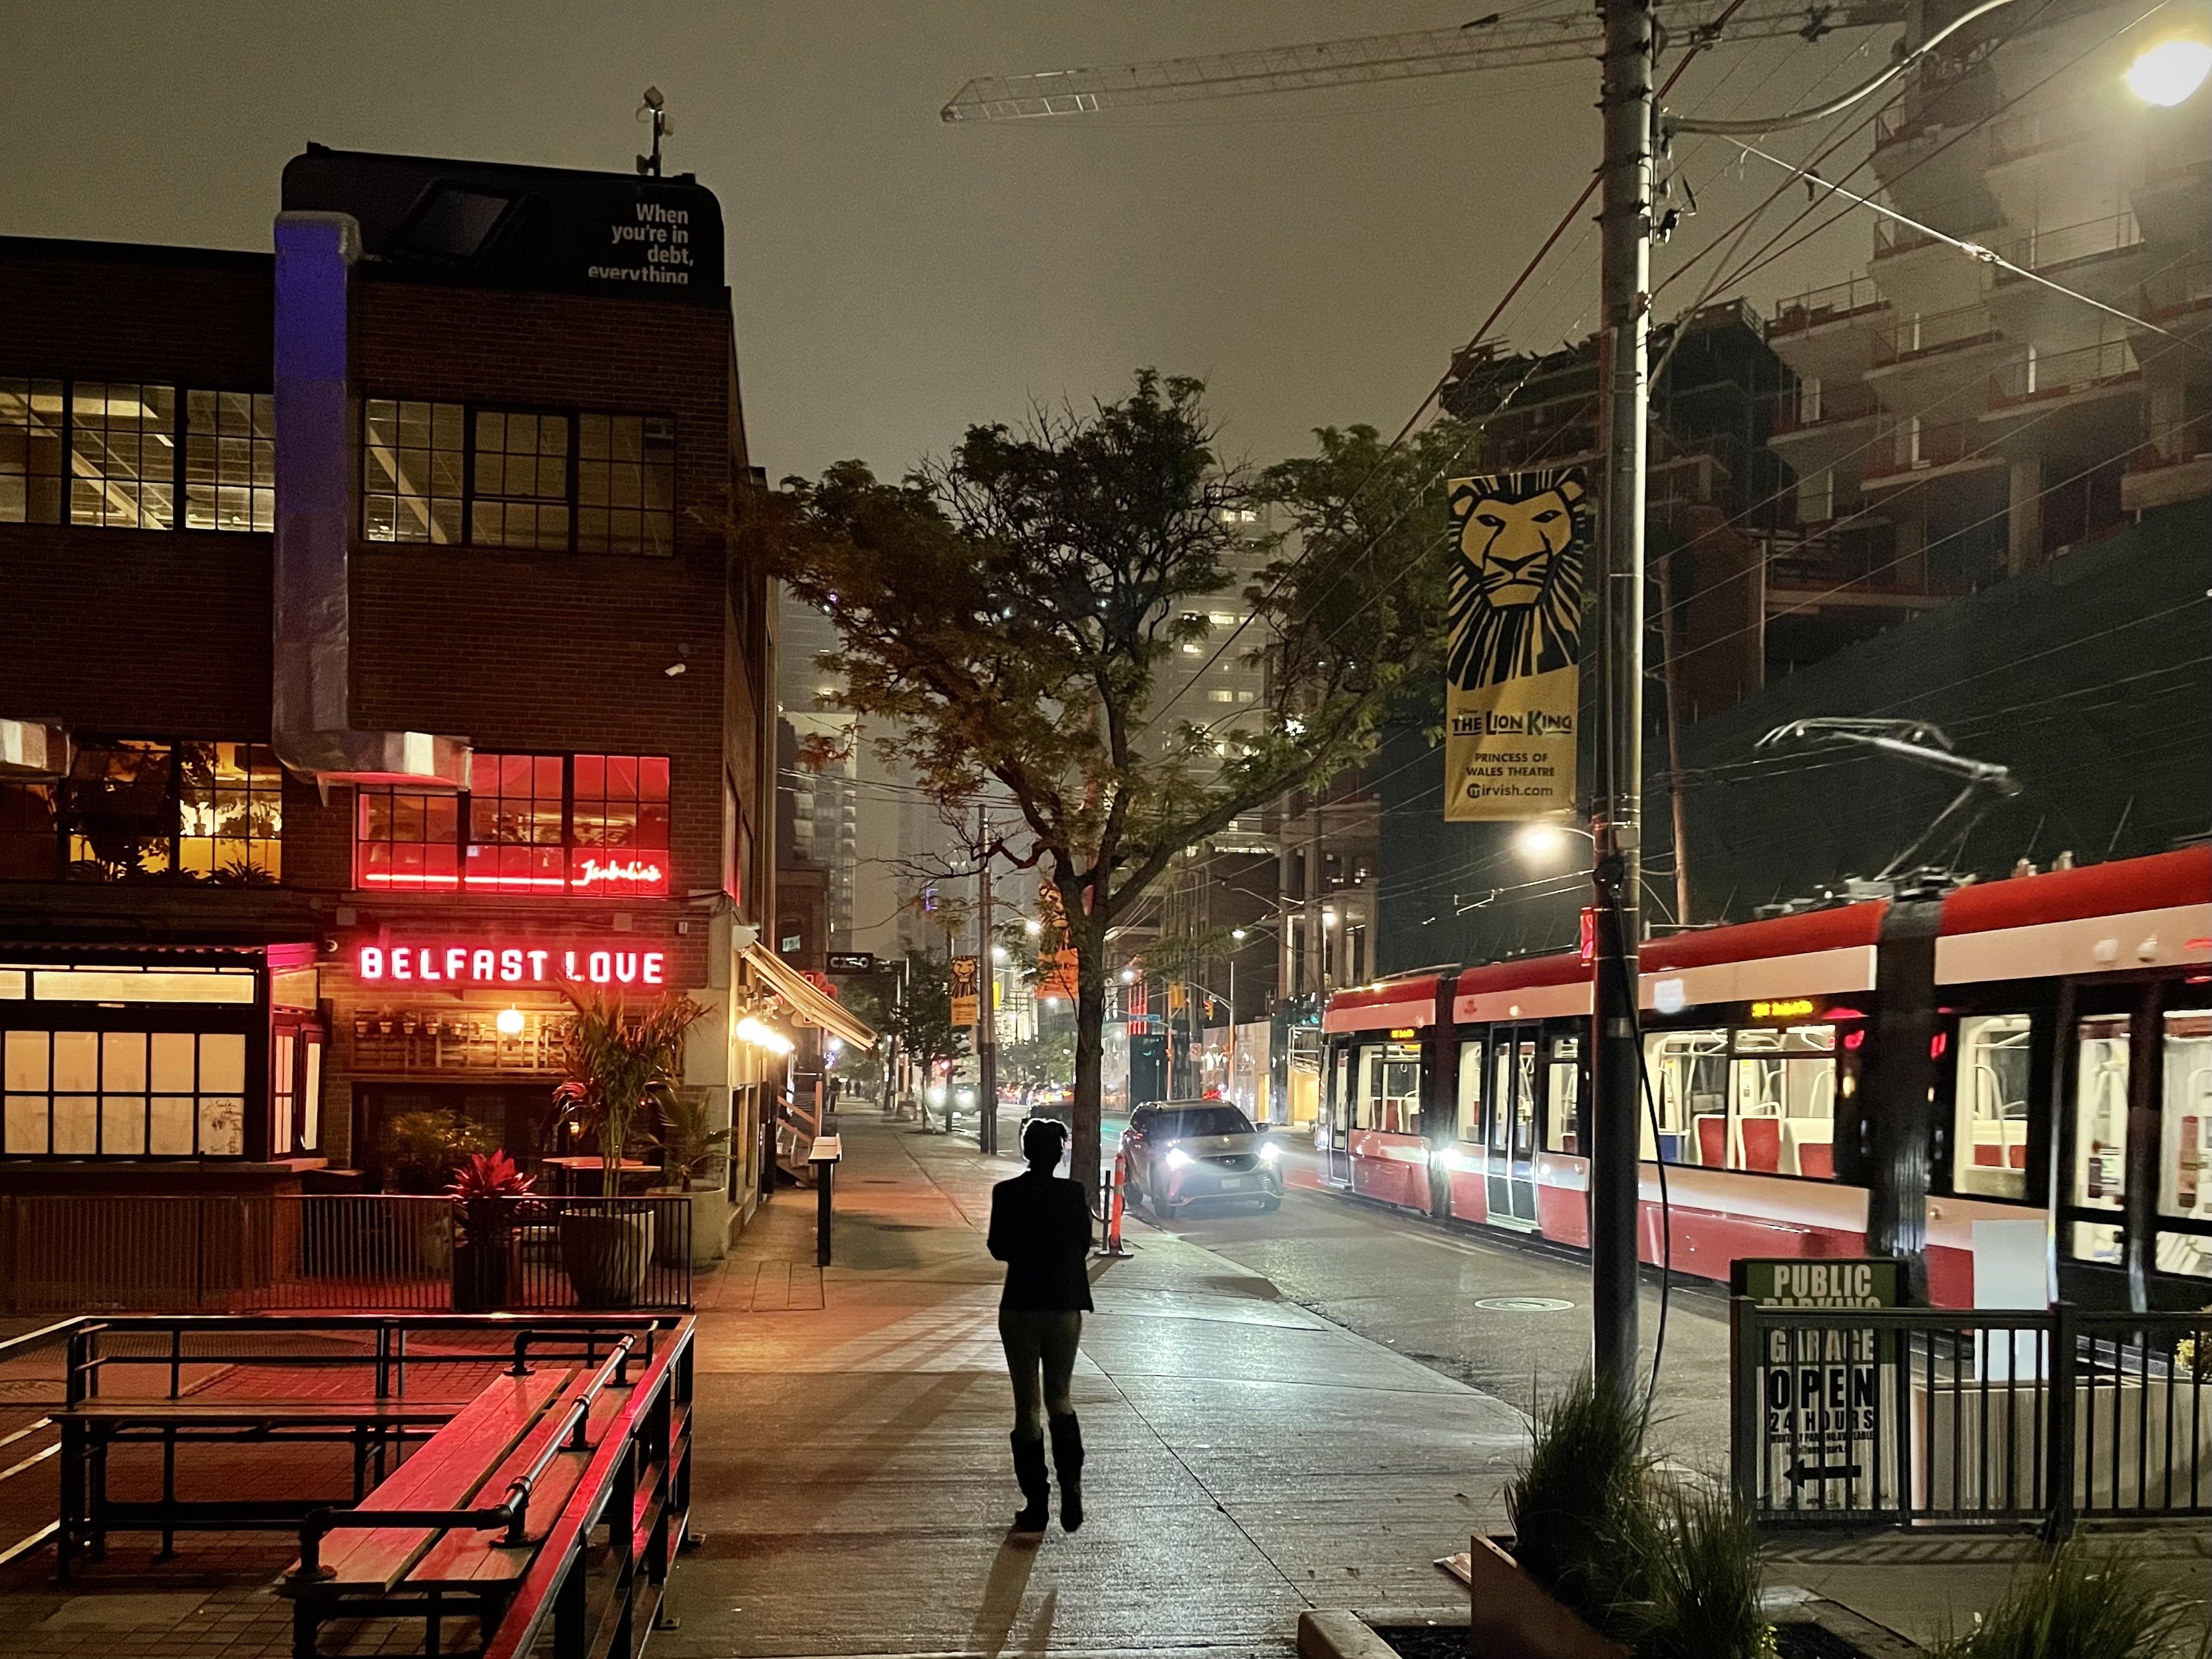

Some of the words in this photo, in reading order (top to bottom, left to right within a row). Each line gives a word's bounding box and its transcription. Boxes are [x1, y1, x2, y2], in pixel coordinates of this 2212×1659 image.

[636, 203, 688, 224] When
[612, 224, 667, 244] you're
[672, 225, 688, 243] in
[648, 244, 693, 266] debt,
[1452, 717, 1482, 732] THE
[1486, 710, 1523, 735] LION
[1527, 710, 1572, 735] KING
[1475, 753, 1528, 762] PRINCESS
[1532, 753, 1548, 762] OF
[1466, 767, 1504, 776] WALES
[1508, 767, 1555, 776] THEATRE
[1466, 783, 1553, 798] mirvish.com
[360, 947, 548, 981] BELFAST
[565, 951, 663, 983] LOVE
[1774, 1265, 1871, 1297] PUBLIC
[1769, 1369, 1874, 1410] OPEN
[1770, 1412, 1793, 1432] 24
